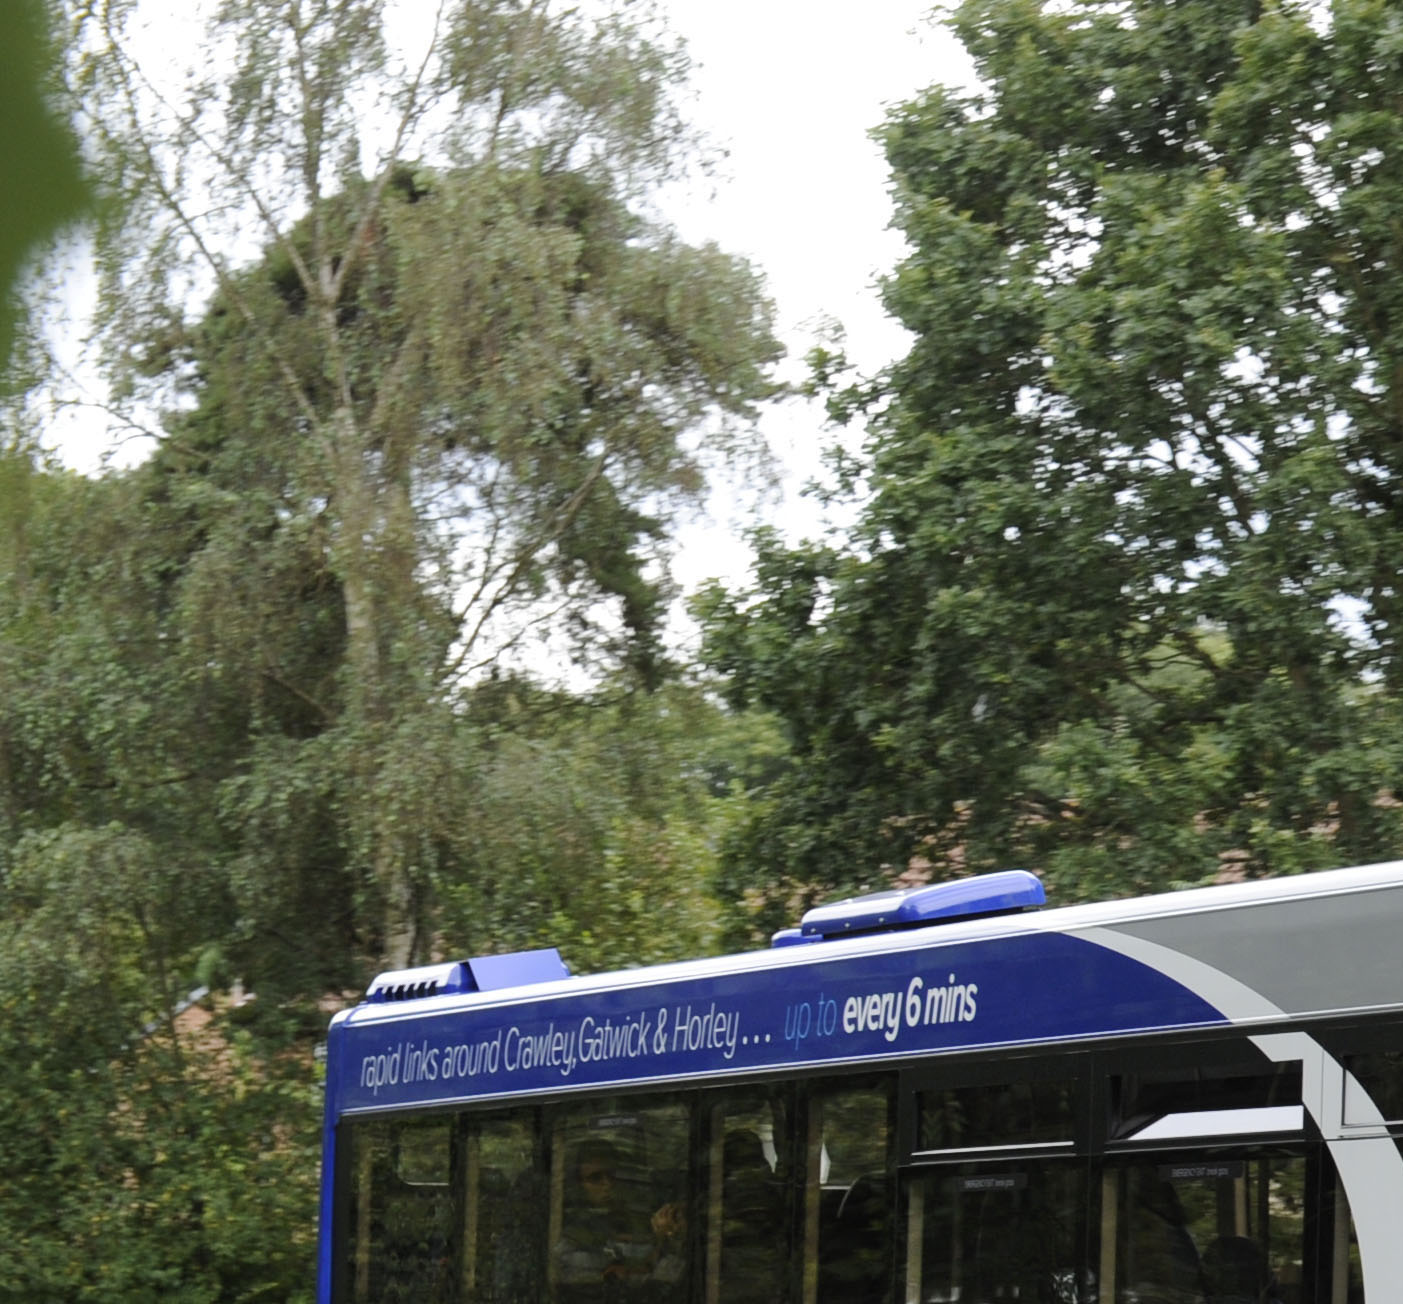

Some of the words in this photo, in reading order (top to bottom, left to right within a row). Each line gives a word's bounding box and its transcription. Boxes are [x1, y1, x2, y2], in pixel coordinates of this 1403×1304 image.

[361, 1043, 402, 1096] rapid
[402, 1040, 439, 1084] links
[442, 1030, 502, 1080] around
[578, 1012, 651, 1063] Gatwick
[652, 1008, 668, 1054] &
[784, 998, 811, 1050] up
[816, 992, 837, 1037] to
[843, 991, 903, 1042] every
[905, 977, 923, 1027] 6
[923, 973, 978, 1026] mins
